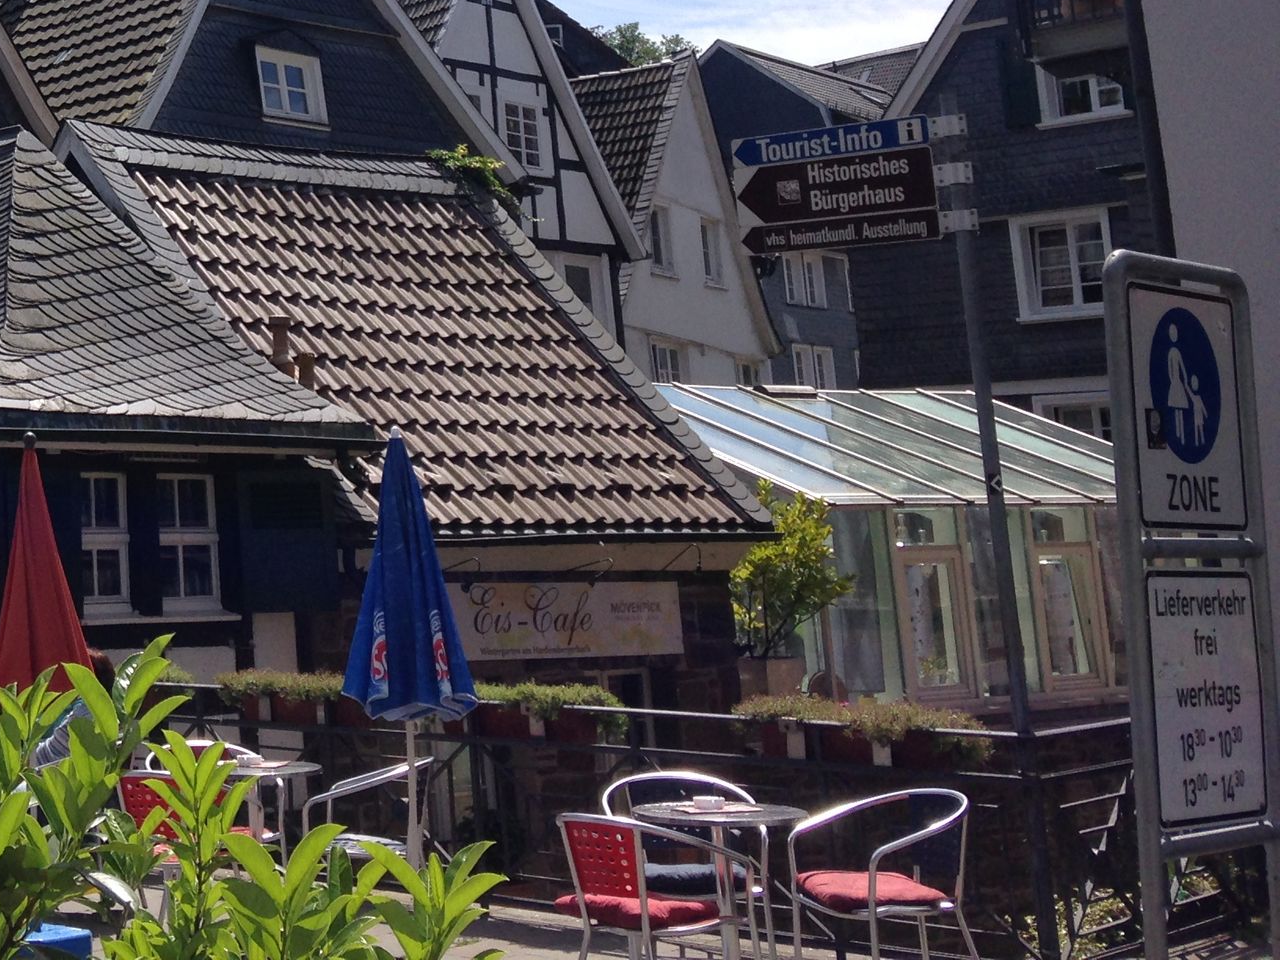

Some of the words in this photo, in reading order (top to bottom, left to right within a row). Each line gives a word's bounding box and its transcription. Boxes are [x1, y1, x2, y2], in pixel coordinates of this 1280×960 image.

[756, 125, 883, 163] Tourist-Info
[807, 156, 910, 185] Historisches
[810, 185, 906, 213] Bürgerhaus
[765, 233, 787, 248] vhs
[789, 226, 859, 246] heimatkundl.
[862, 219, 928, 240] Ausstellung
[1166, 473, 1221, 513] ZONE
[1154, 589, 1246, 617] Lieferverkehr
[1193, 628, 1218, 656] frei
[1176, 679, 1241, 712] werktags
